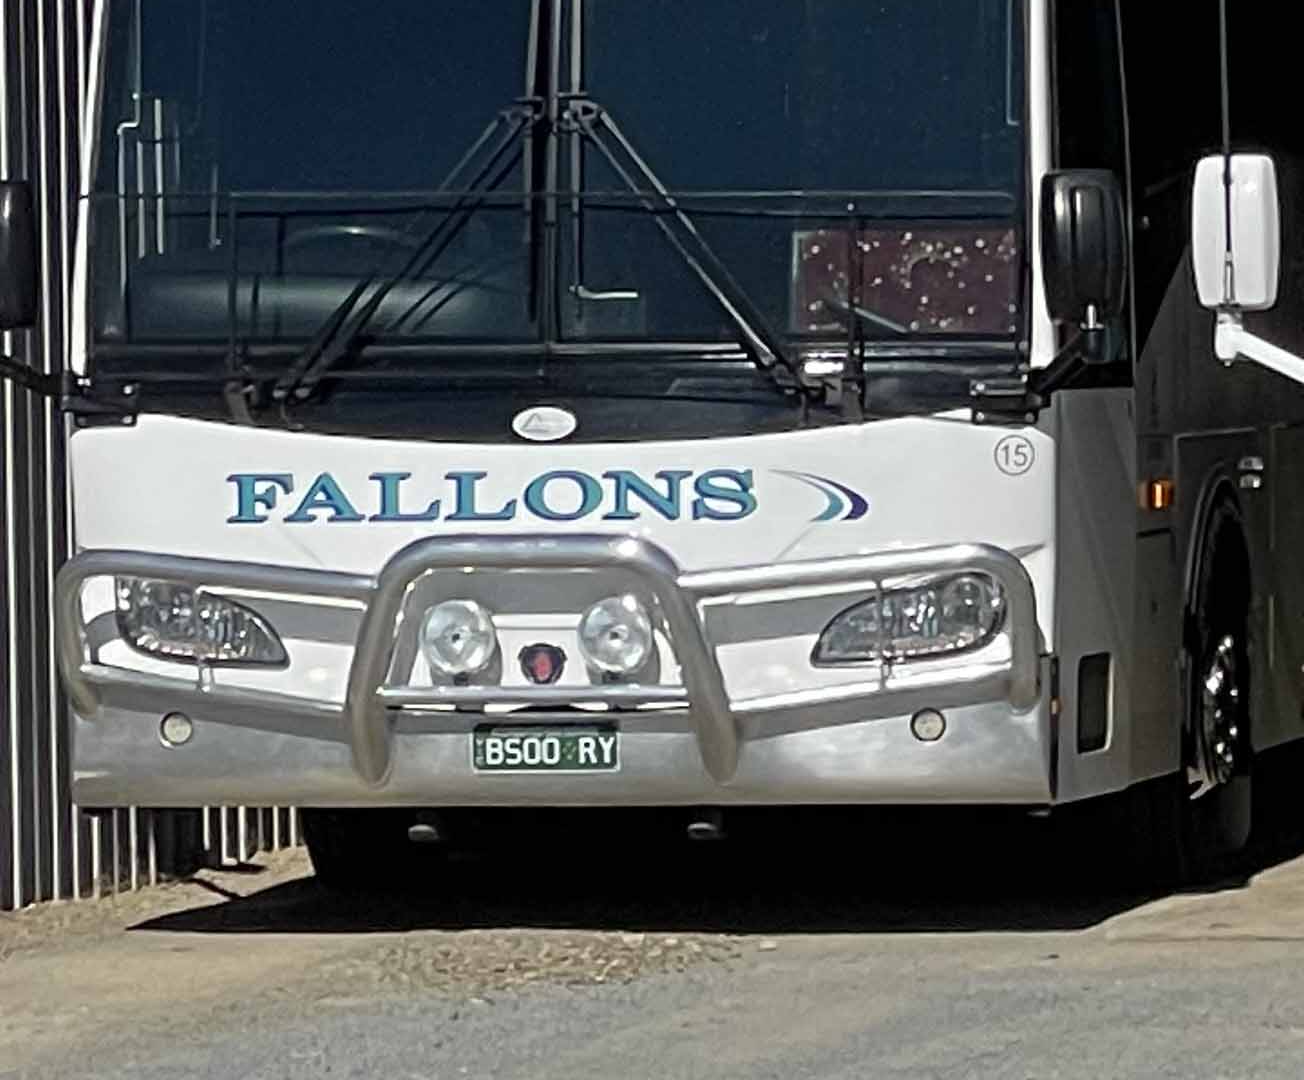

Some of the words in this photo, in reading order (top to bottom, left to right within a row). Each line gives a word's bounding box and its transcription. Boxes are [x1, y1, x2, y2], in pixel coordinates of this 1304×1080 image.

[1000, 443, 1029, 467] 15
[225, 468, 758, 524] FALLONS
[578, 736, 615, 764] RY
